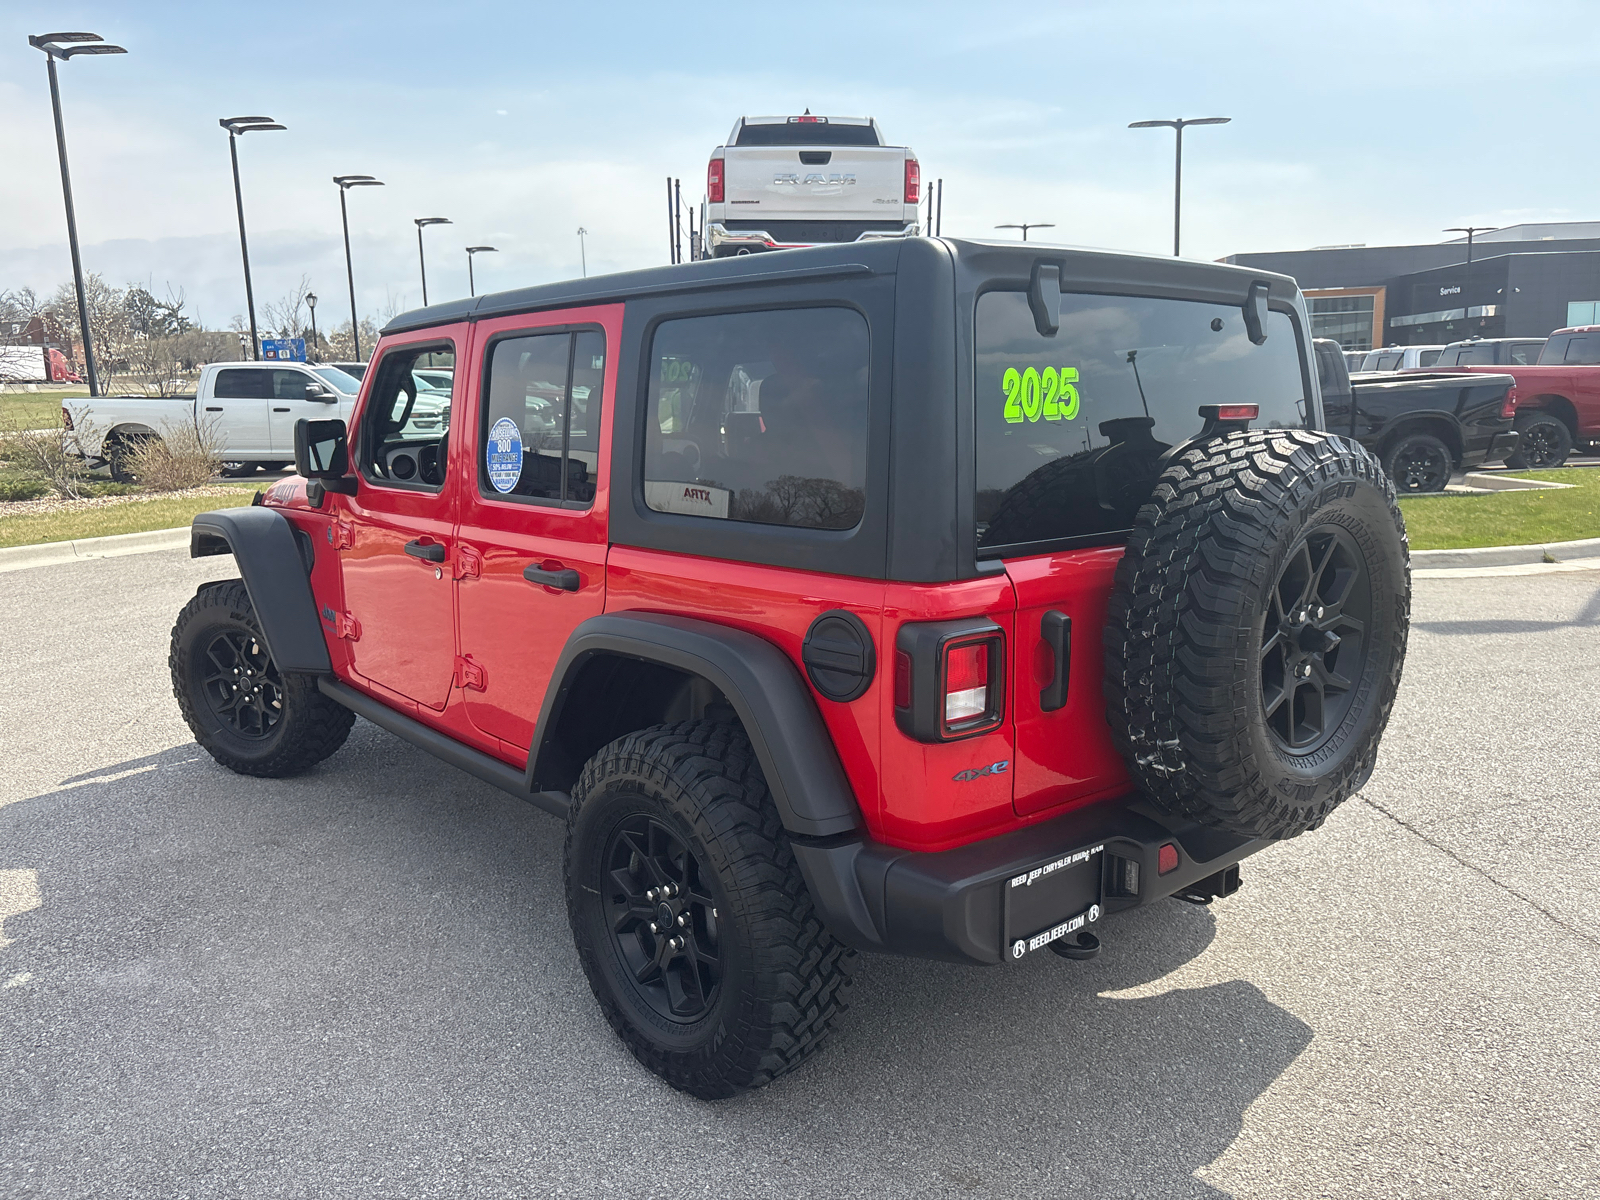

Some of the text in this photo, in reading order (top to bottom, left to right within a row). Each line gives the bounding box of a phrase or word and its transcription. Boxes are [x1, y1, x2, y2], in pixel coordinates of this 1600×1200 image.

[774, 173, 856, 185] RAM
[1440, 285, 1461, 296] Service
[1003, 366, 1080, 424] 2025
[497, 439, 512, 453] 800
[491, 453, 518, 463] MILE RANGE
[952, 760, 1009, 781] 4xe
[1011, 873, 1028, 888] REED
[1028, 867, 1042, 881] JEEP
[1043, 855, 1072, 875] CHRYSLER
[1091, 844, 1104, 855] RAM
[1029, 914, 1085, 952] REEDJEEP.COM
